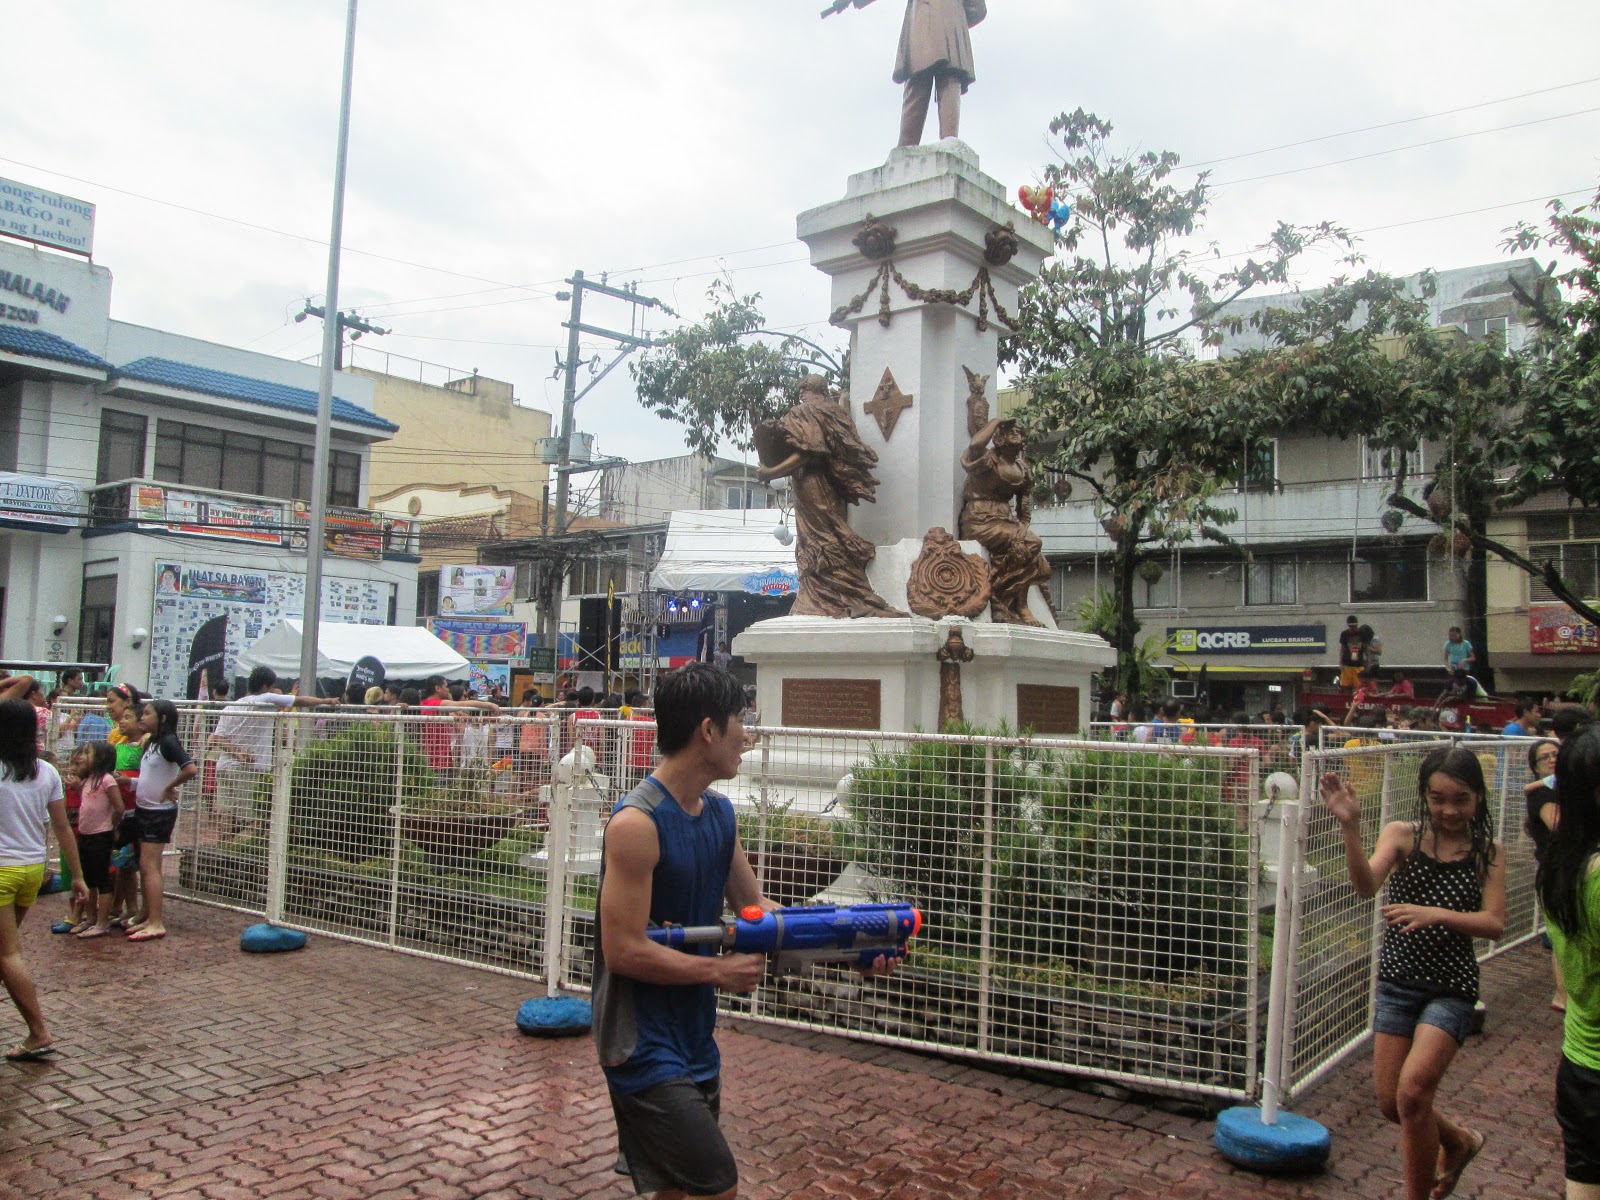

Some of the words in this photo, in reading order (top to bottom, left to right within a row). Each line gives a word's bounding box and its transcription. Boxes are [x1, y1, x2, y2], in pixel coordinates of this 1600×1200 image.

[0, 199, 53, 221] BAGO
[58, 216, 71, 227] at
[32, 224, 86, 247] Lucban!
[16, 485, 51, 501] DATOR
[189, 568, 214, 582] ULAT
[215, 572, 229, 584] SA
[231, 574, 262, 588] BAYAN
[1197, 632, 1251, 649] QCRB
